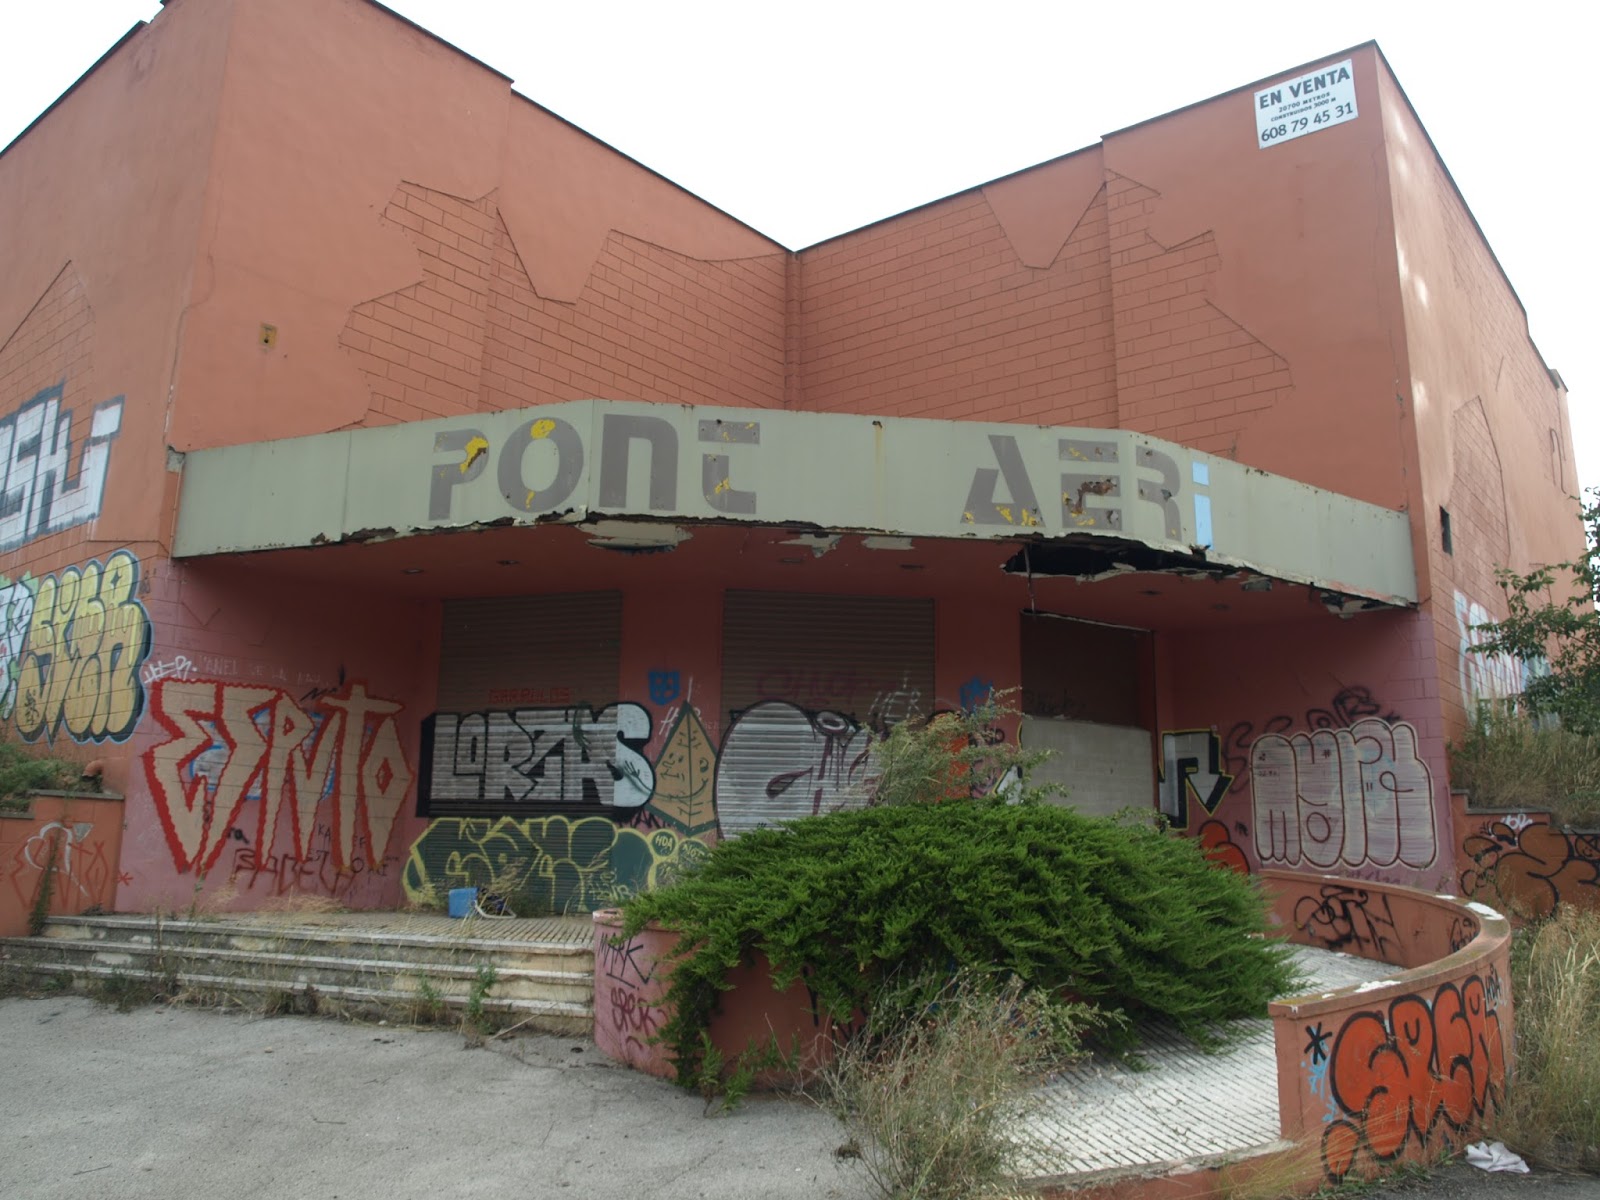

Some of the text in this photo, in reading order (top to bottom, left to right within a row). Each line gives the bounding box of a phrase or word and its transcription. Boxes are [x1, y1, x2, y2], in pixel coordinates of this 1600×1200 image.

[1260, 67, 1350, 109] EN VENTA
[1279, 92, 1331, 113] 20700 METROS
[1261, 102, 1353, 141] 608 79 45 31
[1271, 105, 1312, 122] CONSTRUIDOS
